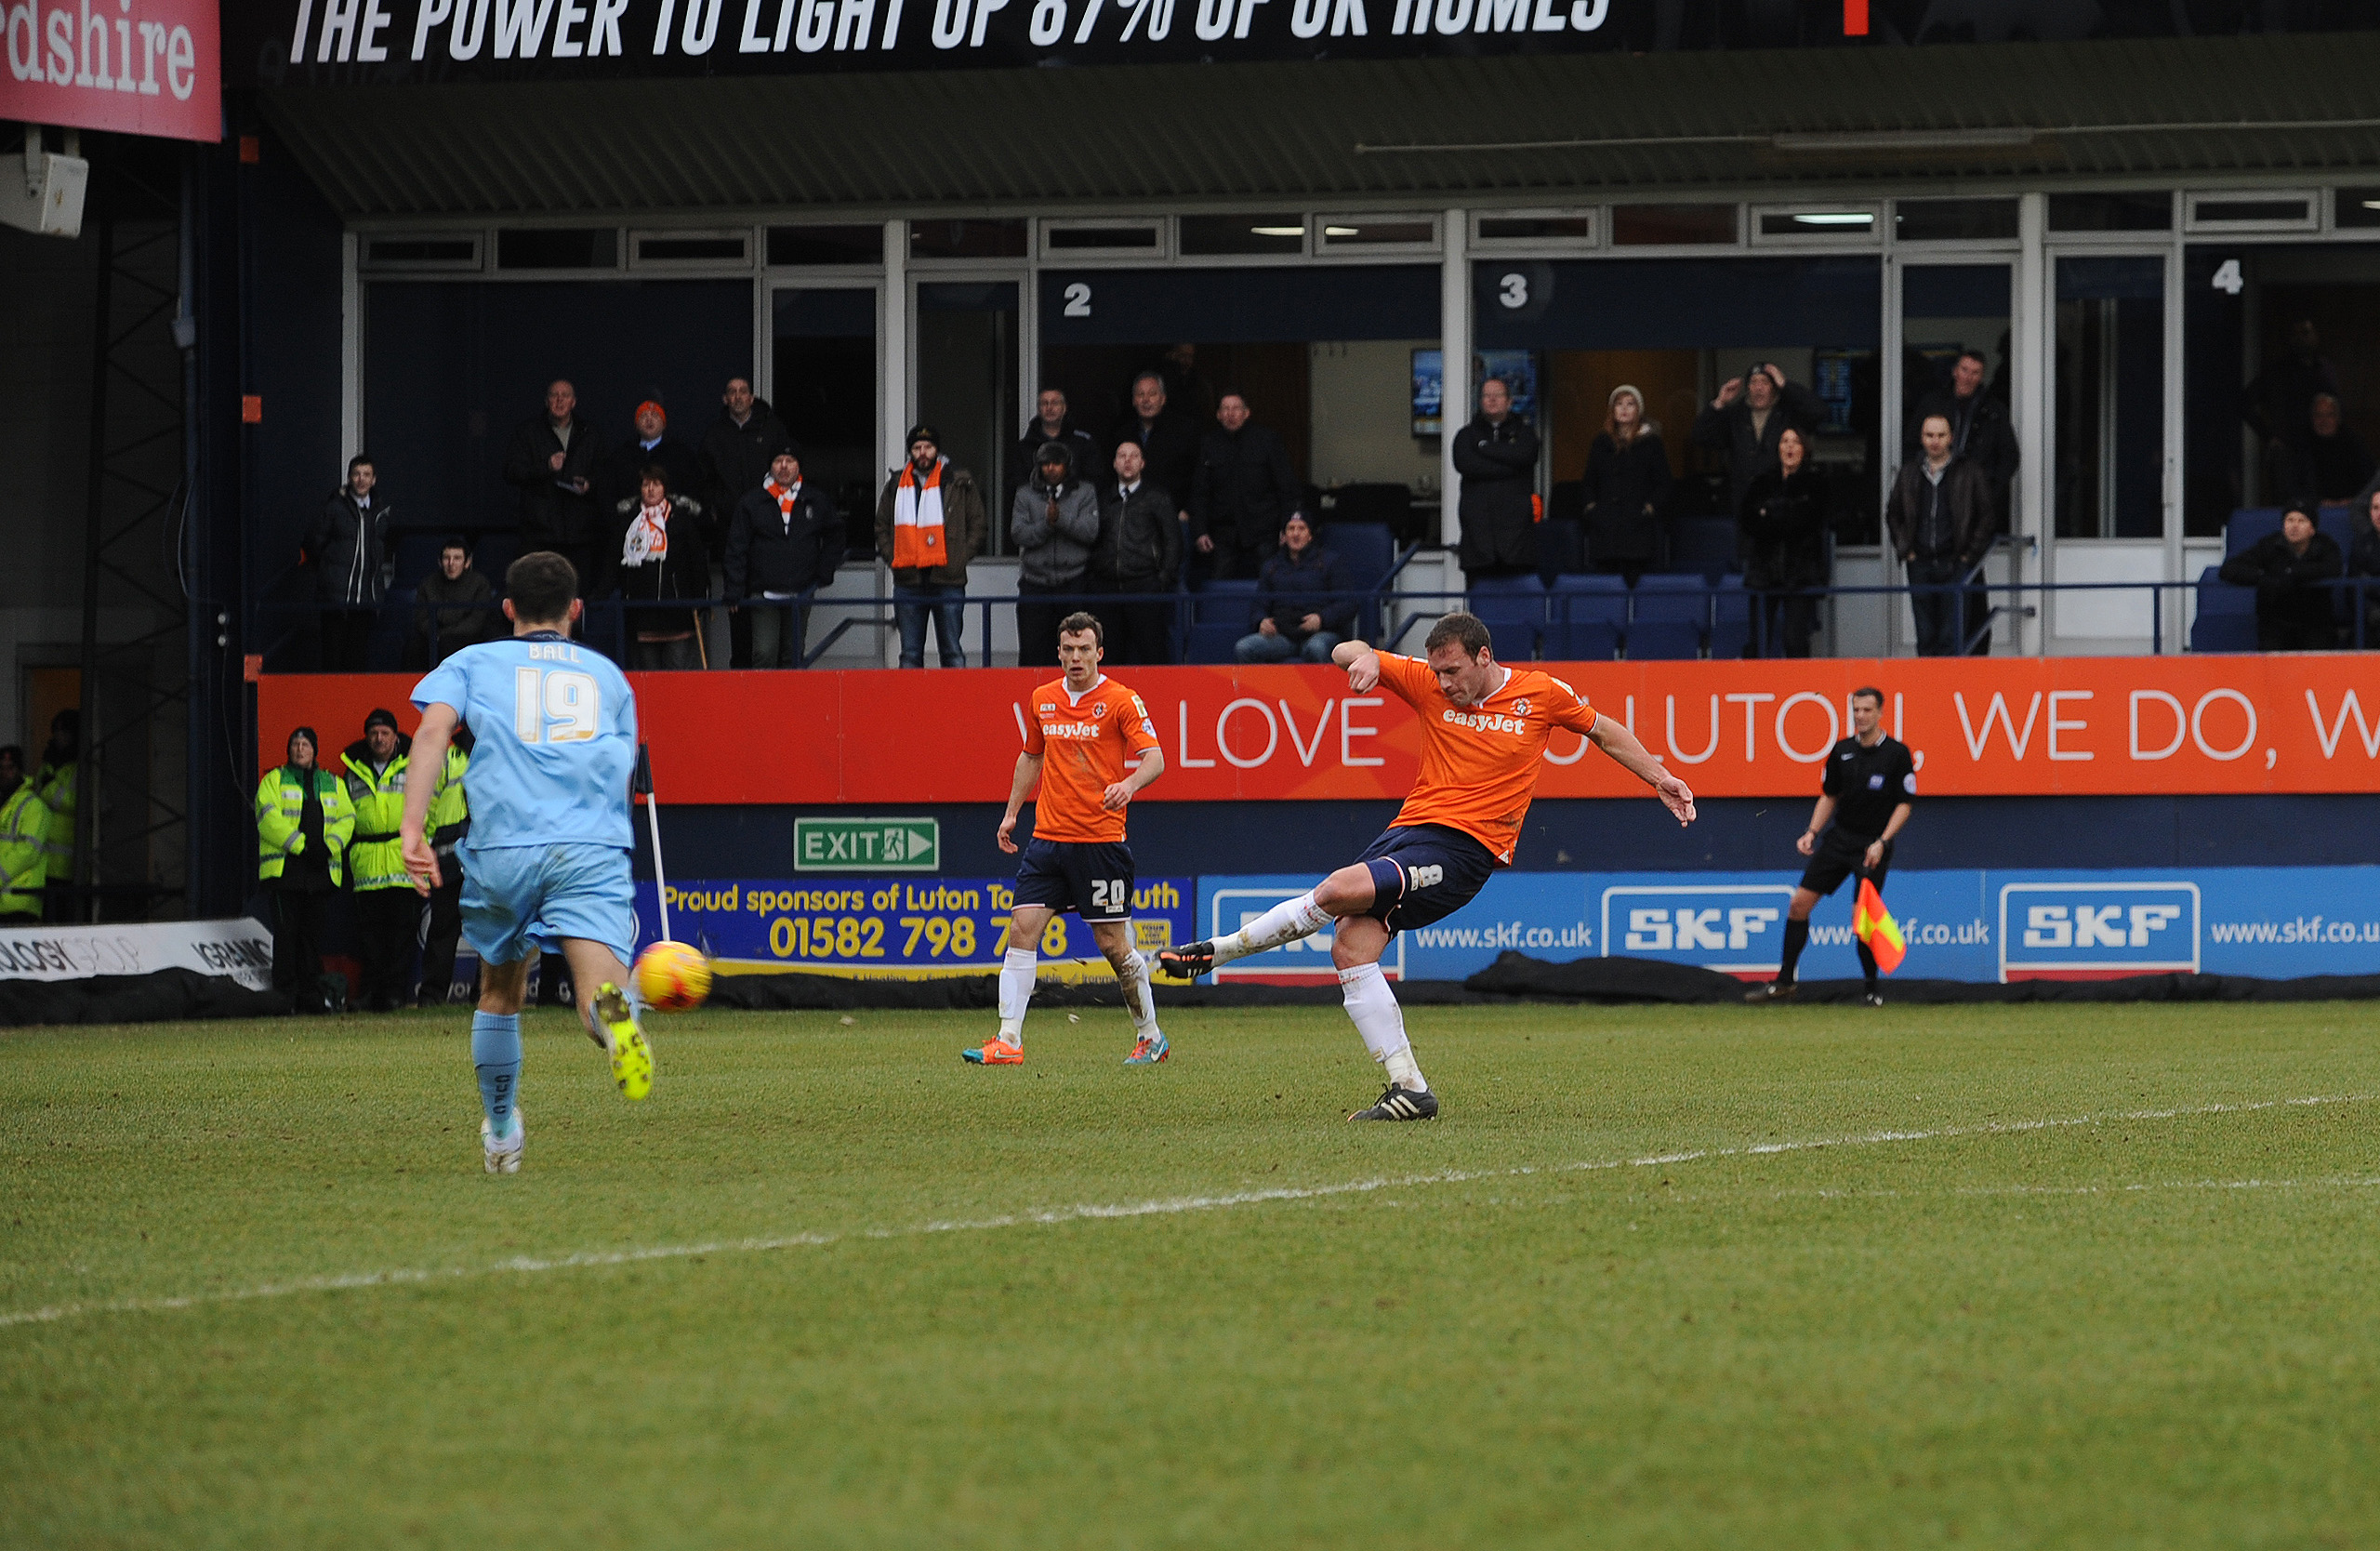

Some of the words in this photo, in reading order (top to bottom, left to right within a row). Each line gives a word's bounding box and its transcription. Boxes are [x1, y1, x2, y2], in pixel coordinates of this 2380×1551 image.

[290, 0, 391, 63] THE
[411, 0, 628, 61] POWER
[0, 0, 195, 101] dshire
[1500, 273, 1527, 308] 3
[2212, 259, 2243, 294] 4
[1064, 283, 1091, 316] 2
[529, 643, 582, 663] BALL
[516, 667, 599, 743] 19
[1443, 709, 1526, 736] easyJet
[1042, 722, 1100, 738] easyJet
[1180, 697, 1385, 768] LOVE
[1953, 691, 2095, 761] WE
[2129, 688, 2278, 770] DO,
[805, 831, 879, 860] EXIT
[664, 884, 738, 911] Proud
[747, 889, 865, 918] sponsors
[872, 883, 900, 911] of
[906, 885, 979, 911] Luton
[987, 884, 1015, 911] To
[1131, 882, 1179, 909] uth
[1091, 879, 1125, 907] 20
[769, 917, 885, 957] 01582
[900, 916, 976, 957] 798
[990, 915, 1067, 957] 78
[1415, 921, 1593, 948] www.skf.co.uk
[1625, 908, 1779, 950] SKF
[2023, 905, 2181, 948] SKF
[0, 939, 78, 972] OLOGY
